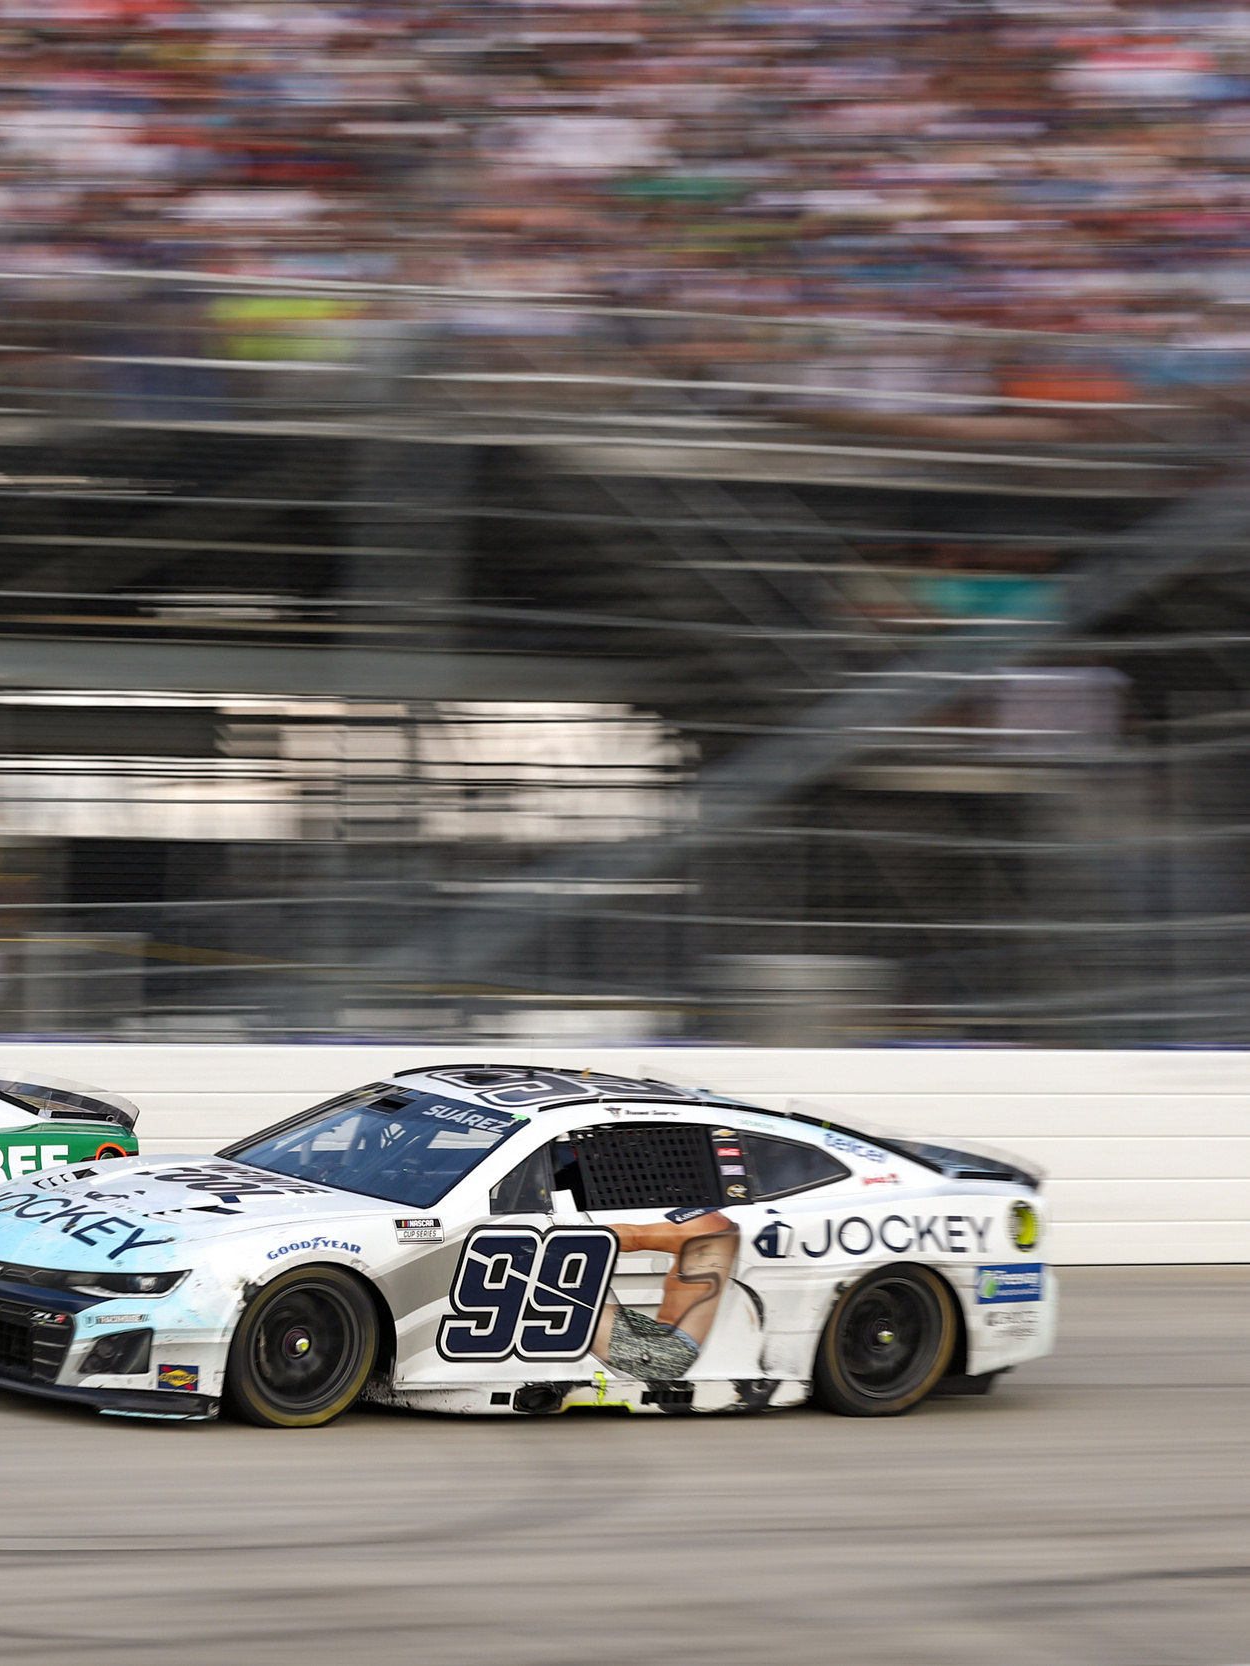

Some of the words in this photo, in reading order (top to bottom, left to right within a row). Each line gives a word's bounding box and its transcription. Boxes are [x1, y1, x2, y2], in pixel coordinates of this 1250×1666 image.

[422, 1103, 507, 1134] SUÁREZ
[403, 1230, 415, 1238] CUP
[416, 1229, 437, 1238] SERIES
[410, 1219, 435, 1227] NASCAR
[801, 1214, 994, 1259] JOCKEY
[436, 1224, 620, 1362] 99
